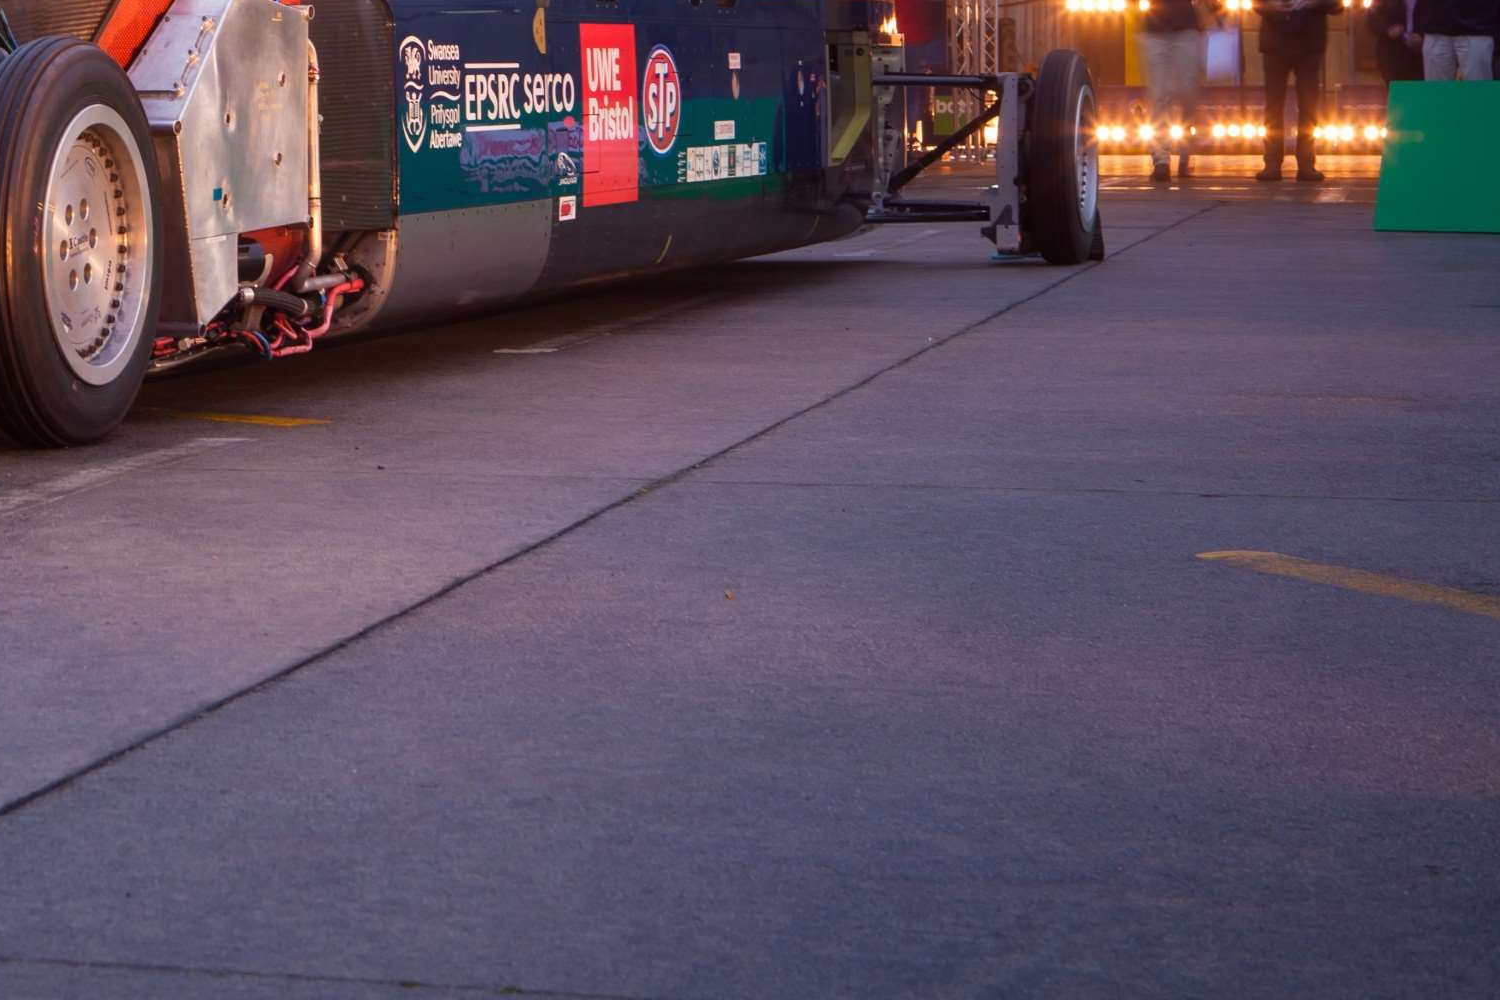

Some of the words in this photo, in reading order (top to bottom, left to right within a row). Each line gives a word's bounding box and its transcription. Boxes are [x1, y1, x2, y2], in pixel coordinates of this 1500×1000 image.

[427, 39, 460, 61] Swansea
[586, 47, 621, 93] UWE
[428, 65, 461, 90] University
[464, 73, 521, 121] EPSRC
[523, 72, 575, 114] serco
[430, 103, 460, 129] Prifysgol
[588, 96, 634, 142] Bristol
[648, 62, 678, 141] STP
[429, 130, 463, 149] Abertawe
